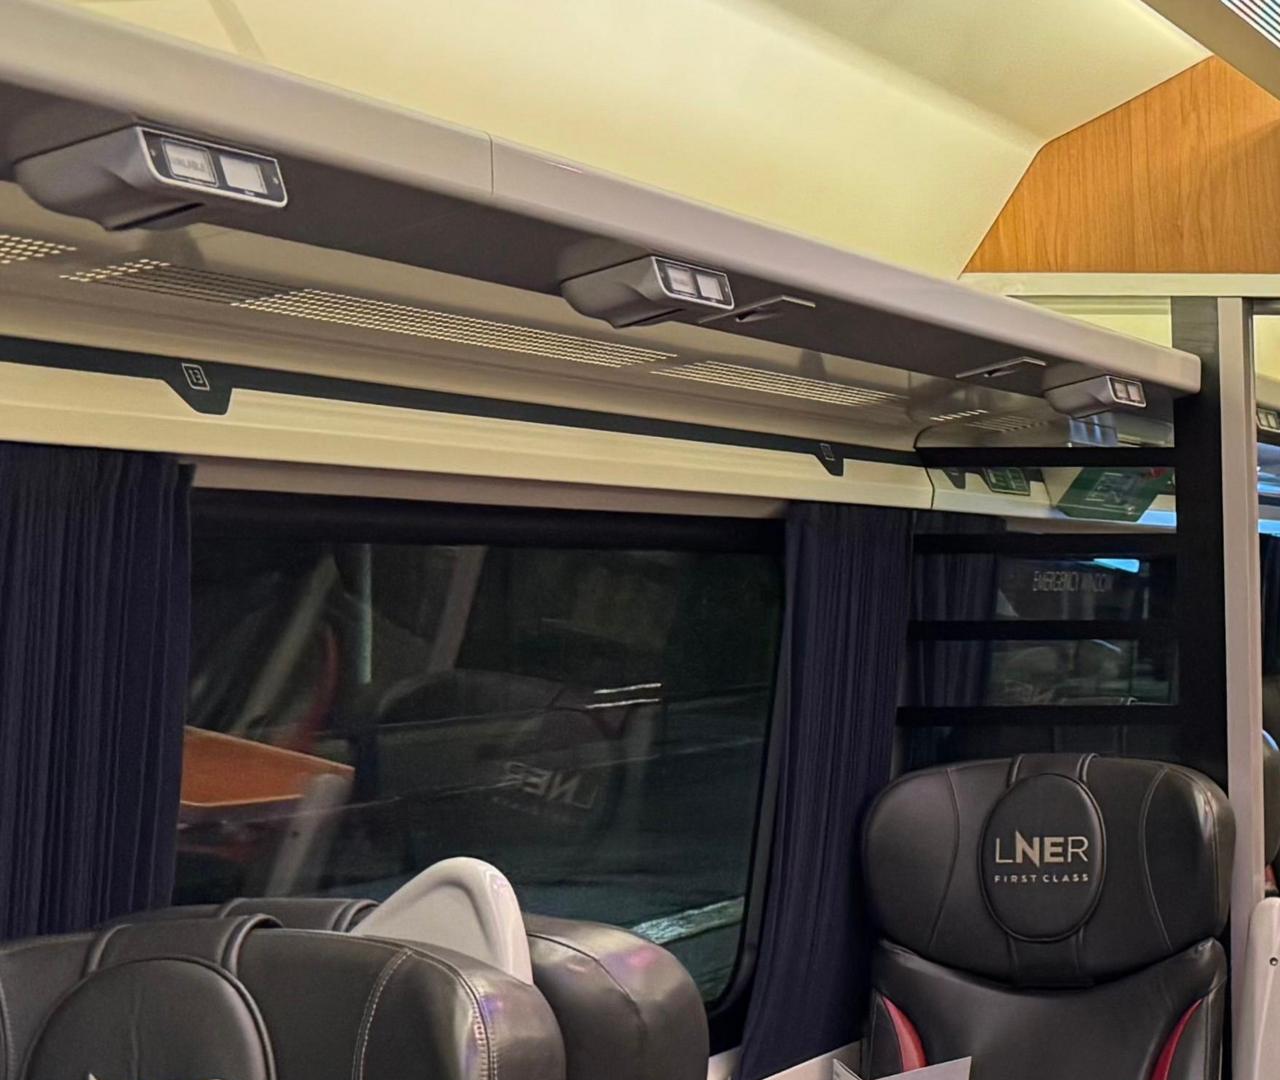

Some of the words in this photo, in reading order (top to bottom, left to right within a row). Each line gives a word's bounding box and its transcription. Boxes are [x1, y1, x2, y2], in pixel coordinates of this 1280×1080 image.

[994, 829, 1090, 869] LNER
[993, 874, 1038, 884] FIRST
[1041, 873, 1090, 883] CLASS
